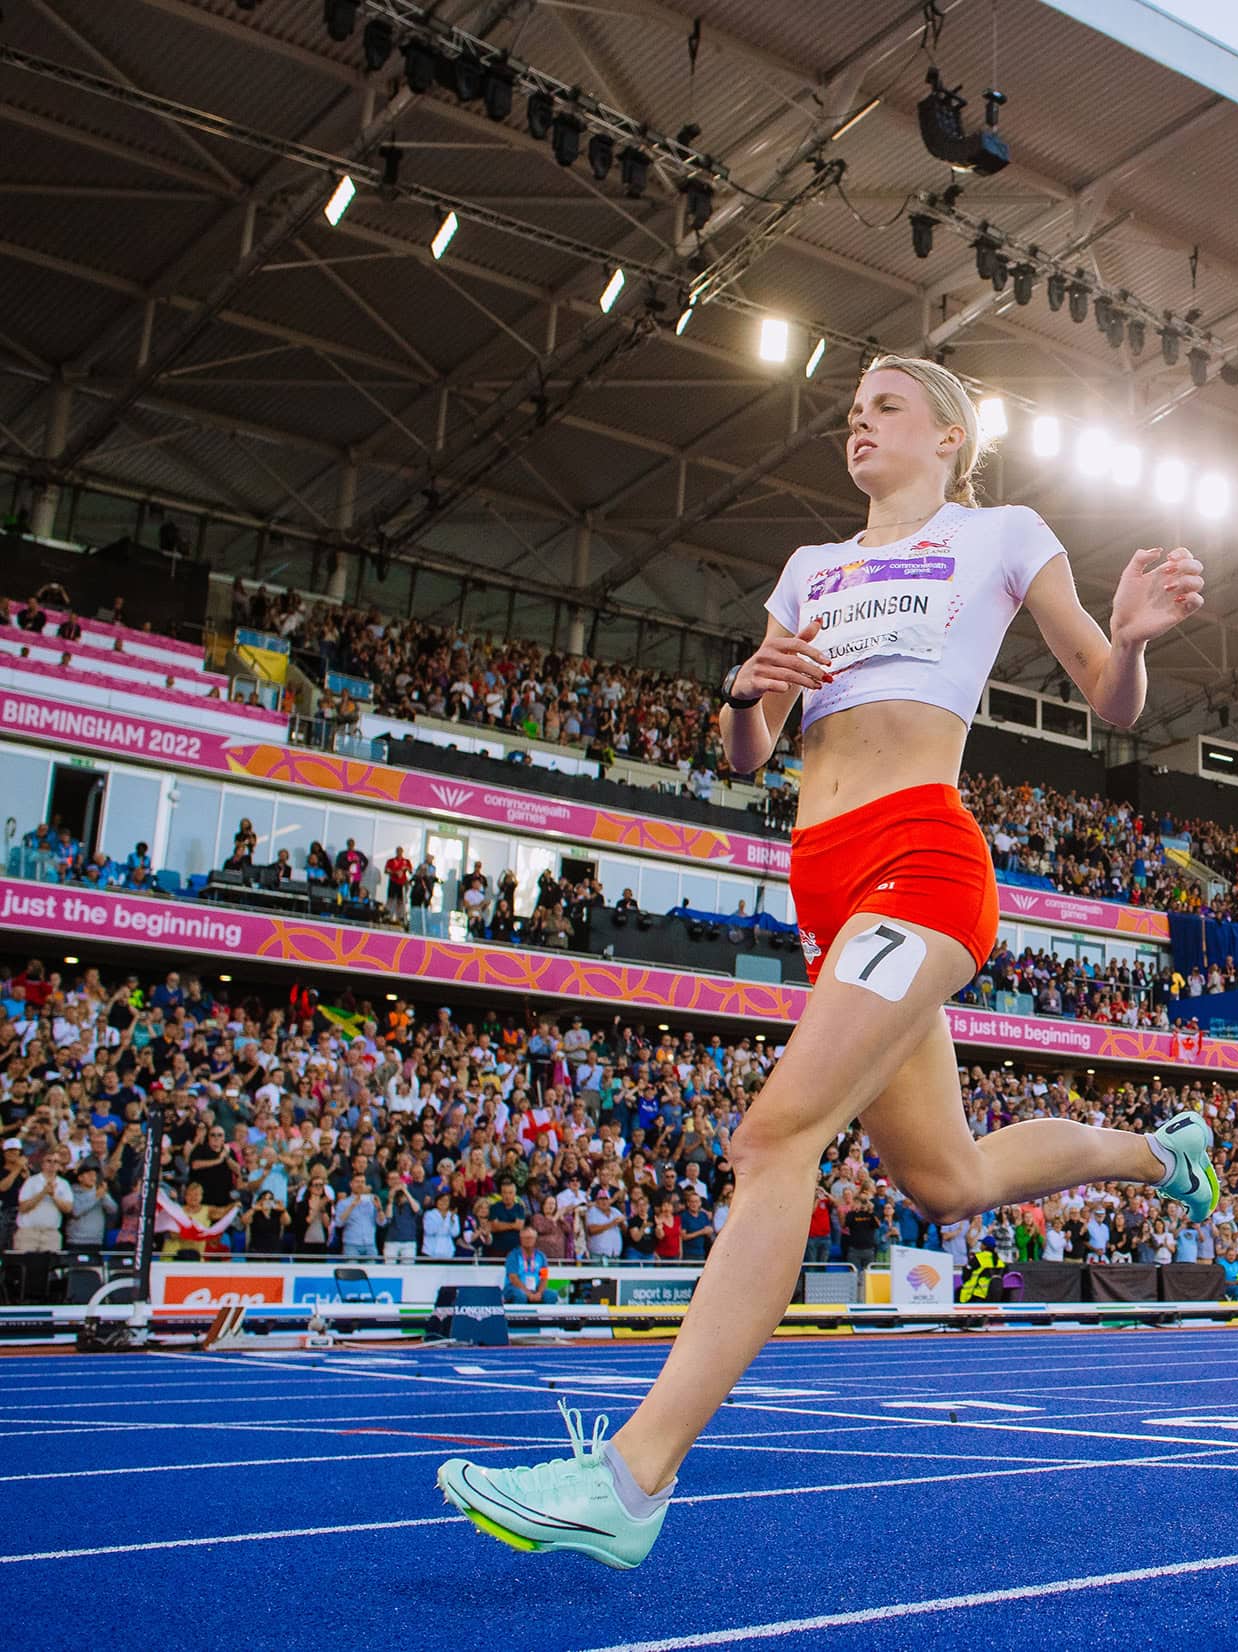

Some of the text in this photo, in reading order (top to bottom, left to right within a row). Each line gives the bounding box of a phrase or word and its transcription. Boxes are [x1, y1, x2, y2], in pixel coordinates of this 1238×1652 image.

[2, 700, 201, 759] BIRMINGHAM 2022
[484, 794, 570, 819] commonwealth
[747, 845, 791, 868] BIRMIN
[1, 889, 242, 947] just the beginning
[858, 925, 906, 981] 7
[954, 1016, 967, 1032] is
[968, 1017, 997, 1036] just
[999, 1021, 1021, 1039] the
[1024, 1024, 1091, 1050] beginning
[633, 1288, 660, 1299] sport
[662, 1289, 672, 1299] is
[454, 1306, 504, 1316] LONGINES
